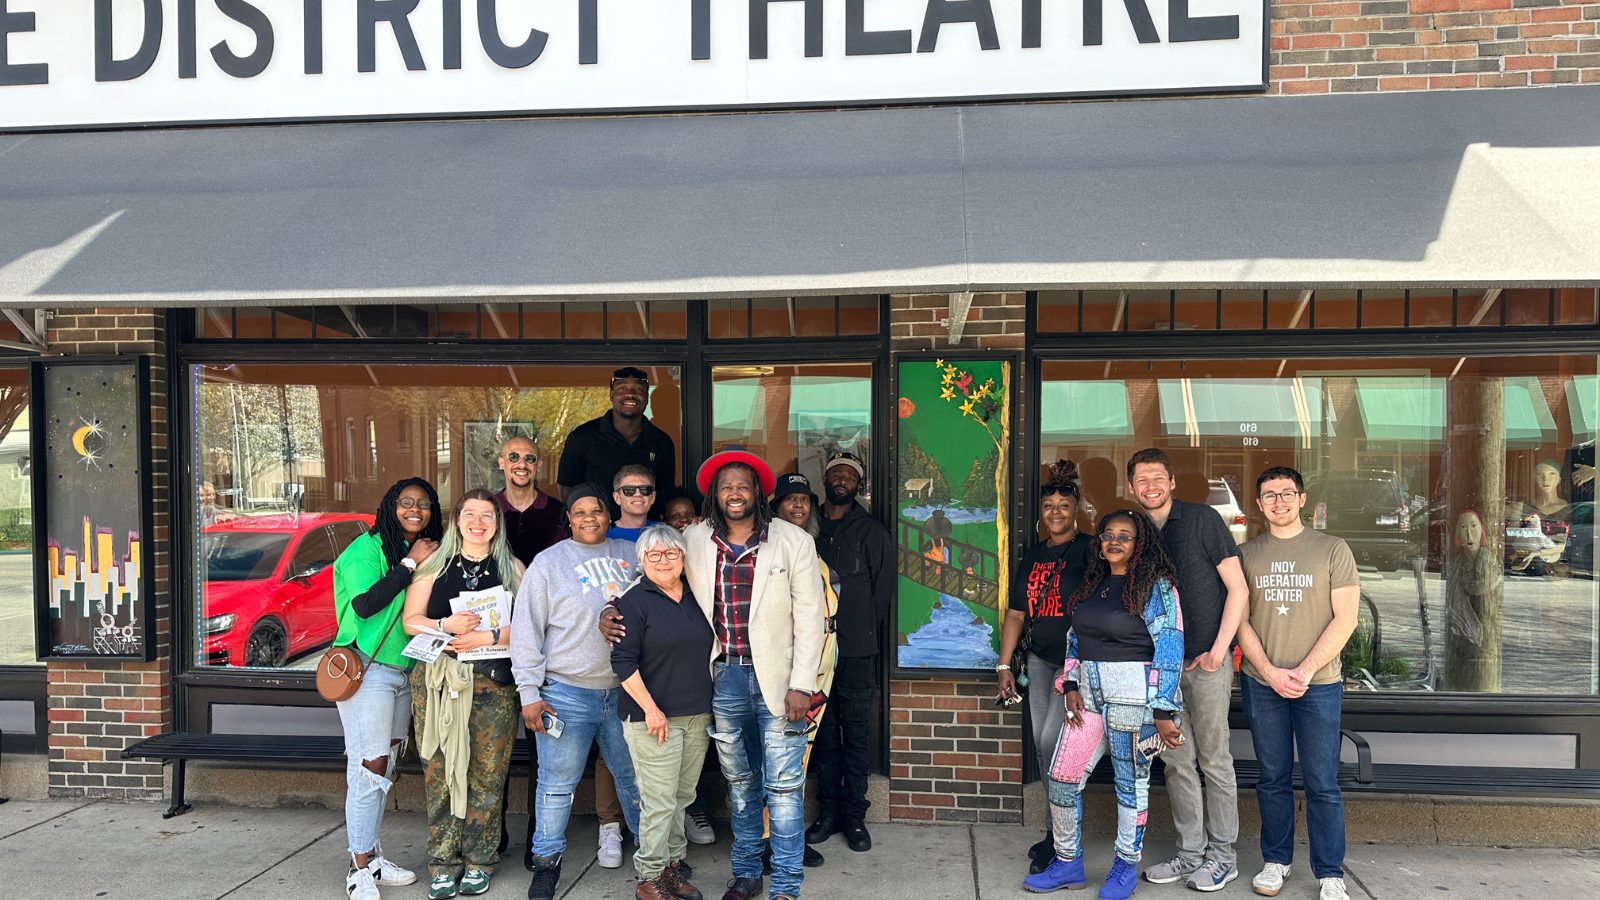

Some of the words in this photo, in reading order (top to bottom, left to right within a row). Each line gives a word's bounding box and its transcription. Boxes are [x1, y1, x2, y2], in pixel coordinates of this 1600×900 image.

[1271, 561, 1296, 573] INDY
[1255, 574, 1313, 589] LIBERATION
[1264, 588, 1303, 602] CENTER
